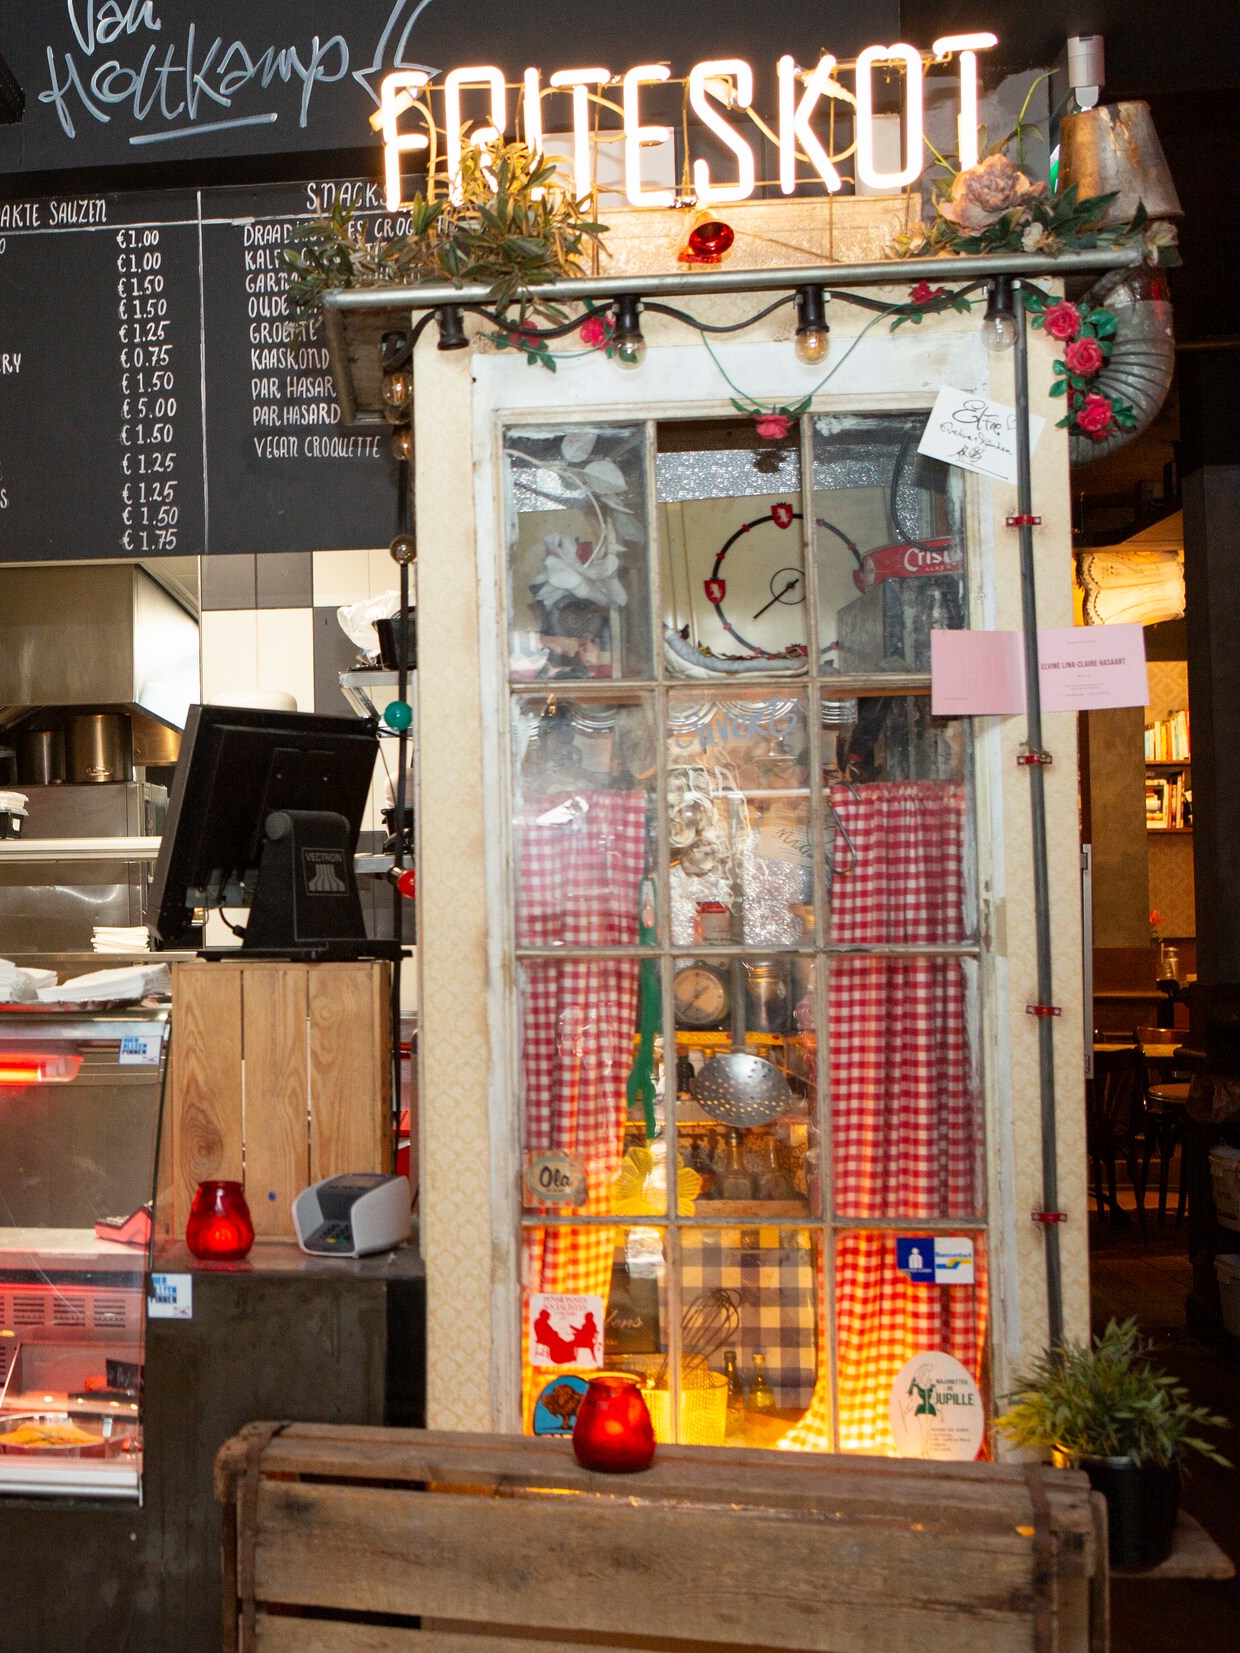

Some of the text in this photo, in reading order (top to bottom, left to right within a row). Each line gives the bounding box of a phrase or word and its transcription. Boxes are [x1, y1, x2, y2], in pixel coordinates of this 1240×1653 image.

[49, 199, 107, 225] SAUZEN
[248, 294, 289, 318] OUDE
[252, 377, 281, 400] PAR
[253, 406, 281, 426] PAR
[254, 436, 381, 458] VEGAN CROQUETTE
